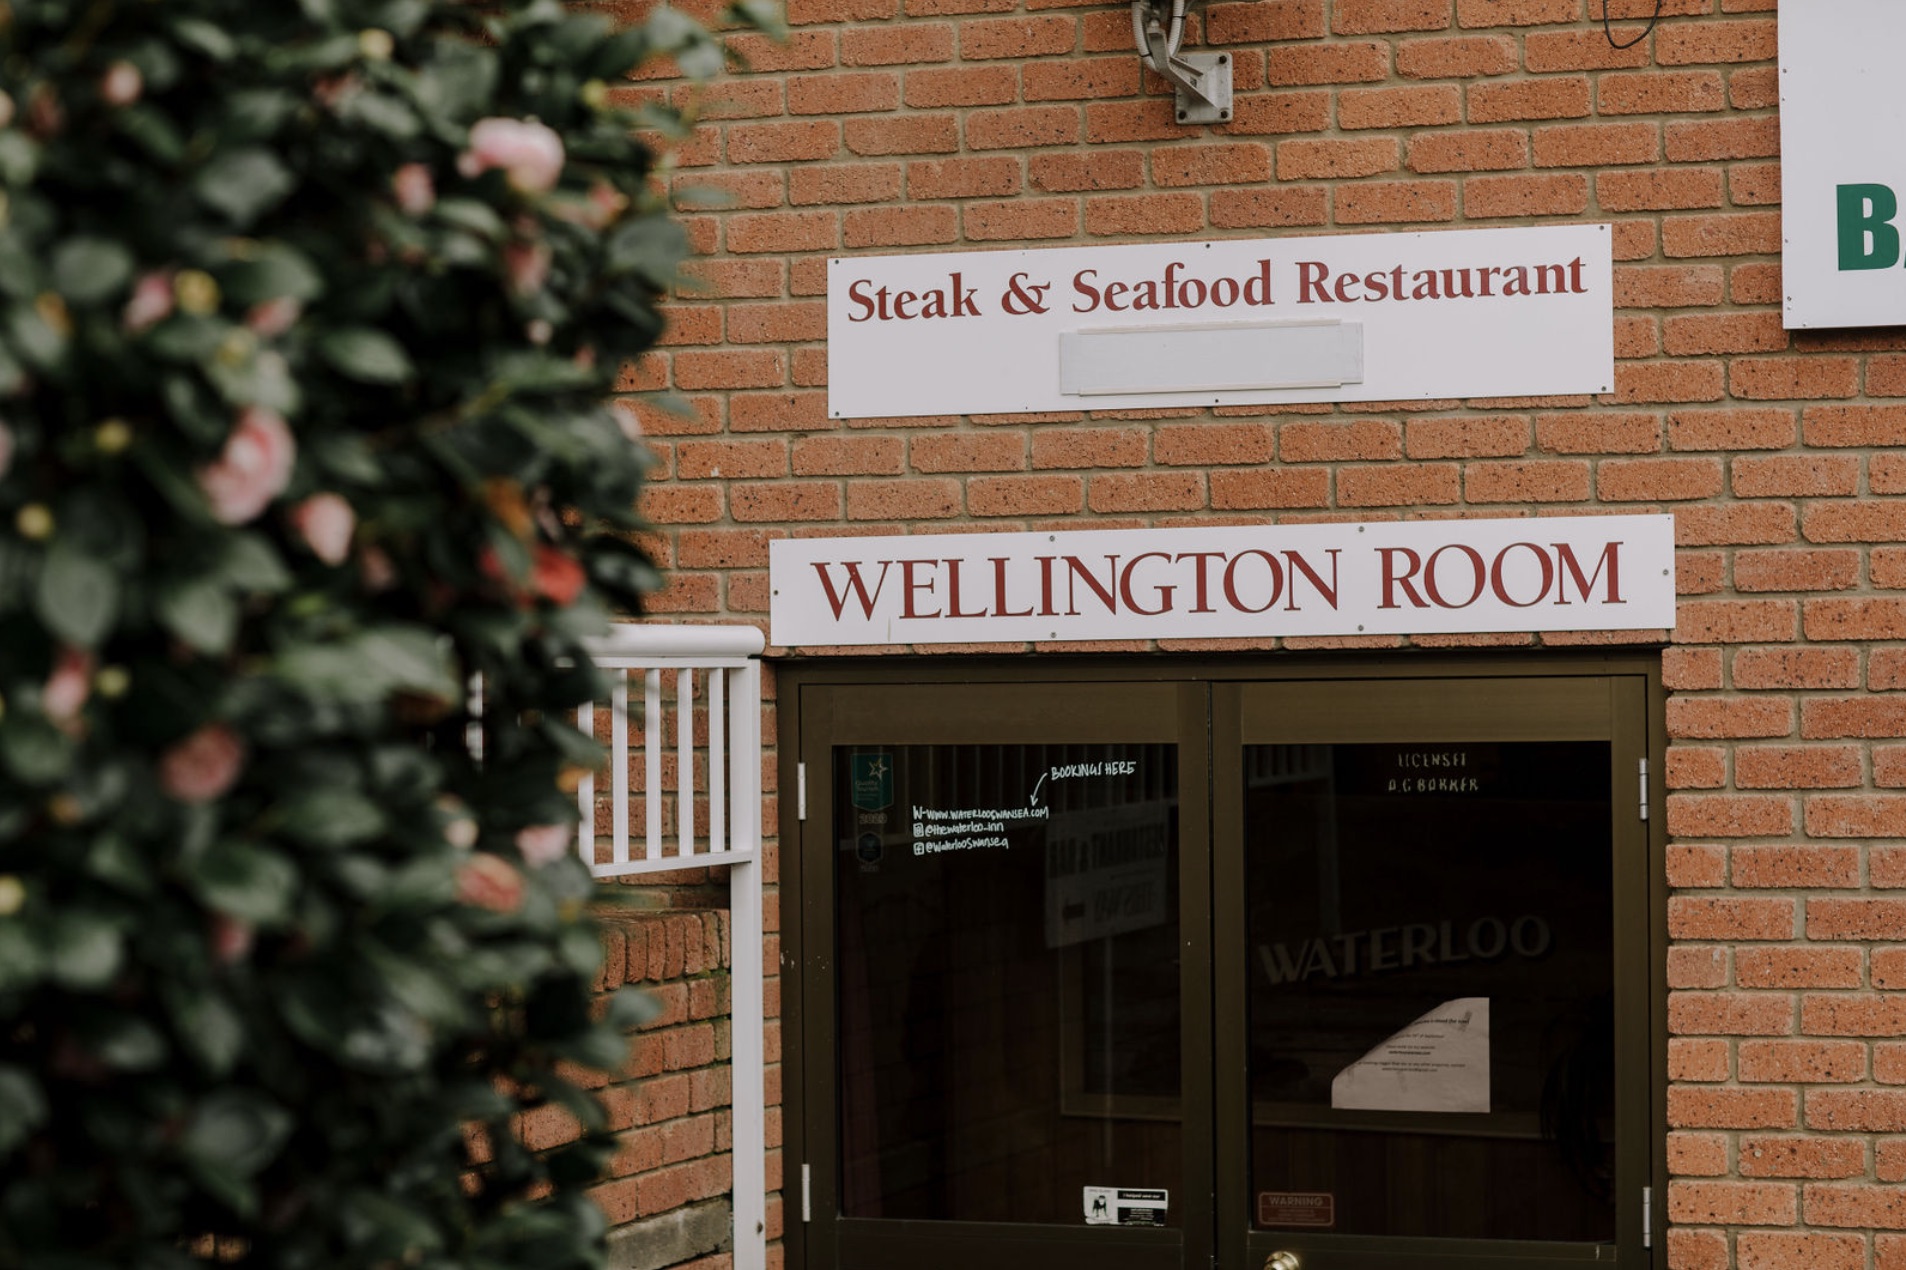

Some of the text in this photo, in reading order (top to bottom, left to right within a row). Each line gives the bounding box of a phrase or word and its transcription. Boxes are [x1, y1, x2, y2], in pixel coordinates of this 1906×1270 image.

[1836, 183, 1906, 272] B
[848, 256, 1589, 322] Steak & Seafood Restaurant
[810, 540, 1627, 622] WELLINGTON ROOM
[1051, 760, 1137, 781] BOOKINGS HERE
[1257, 913, 1553, 986] WATERLOO
[1268, 1195, 1324, 1207] WARNING
